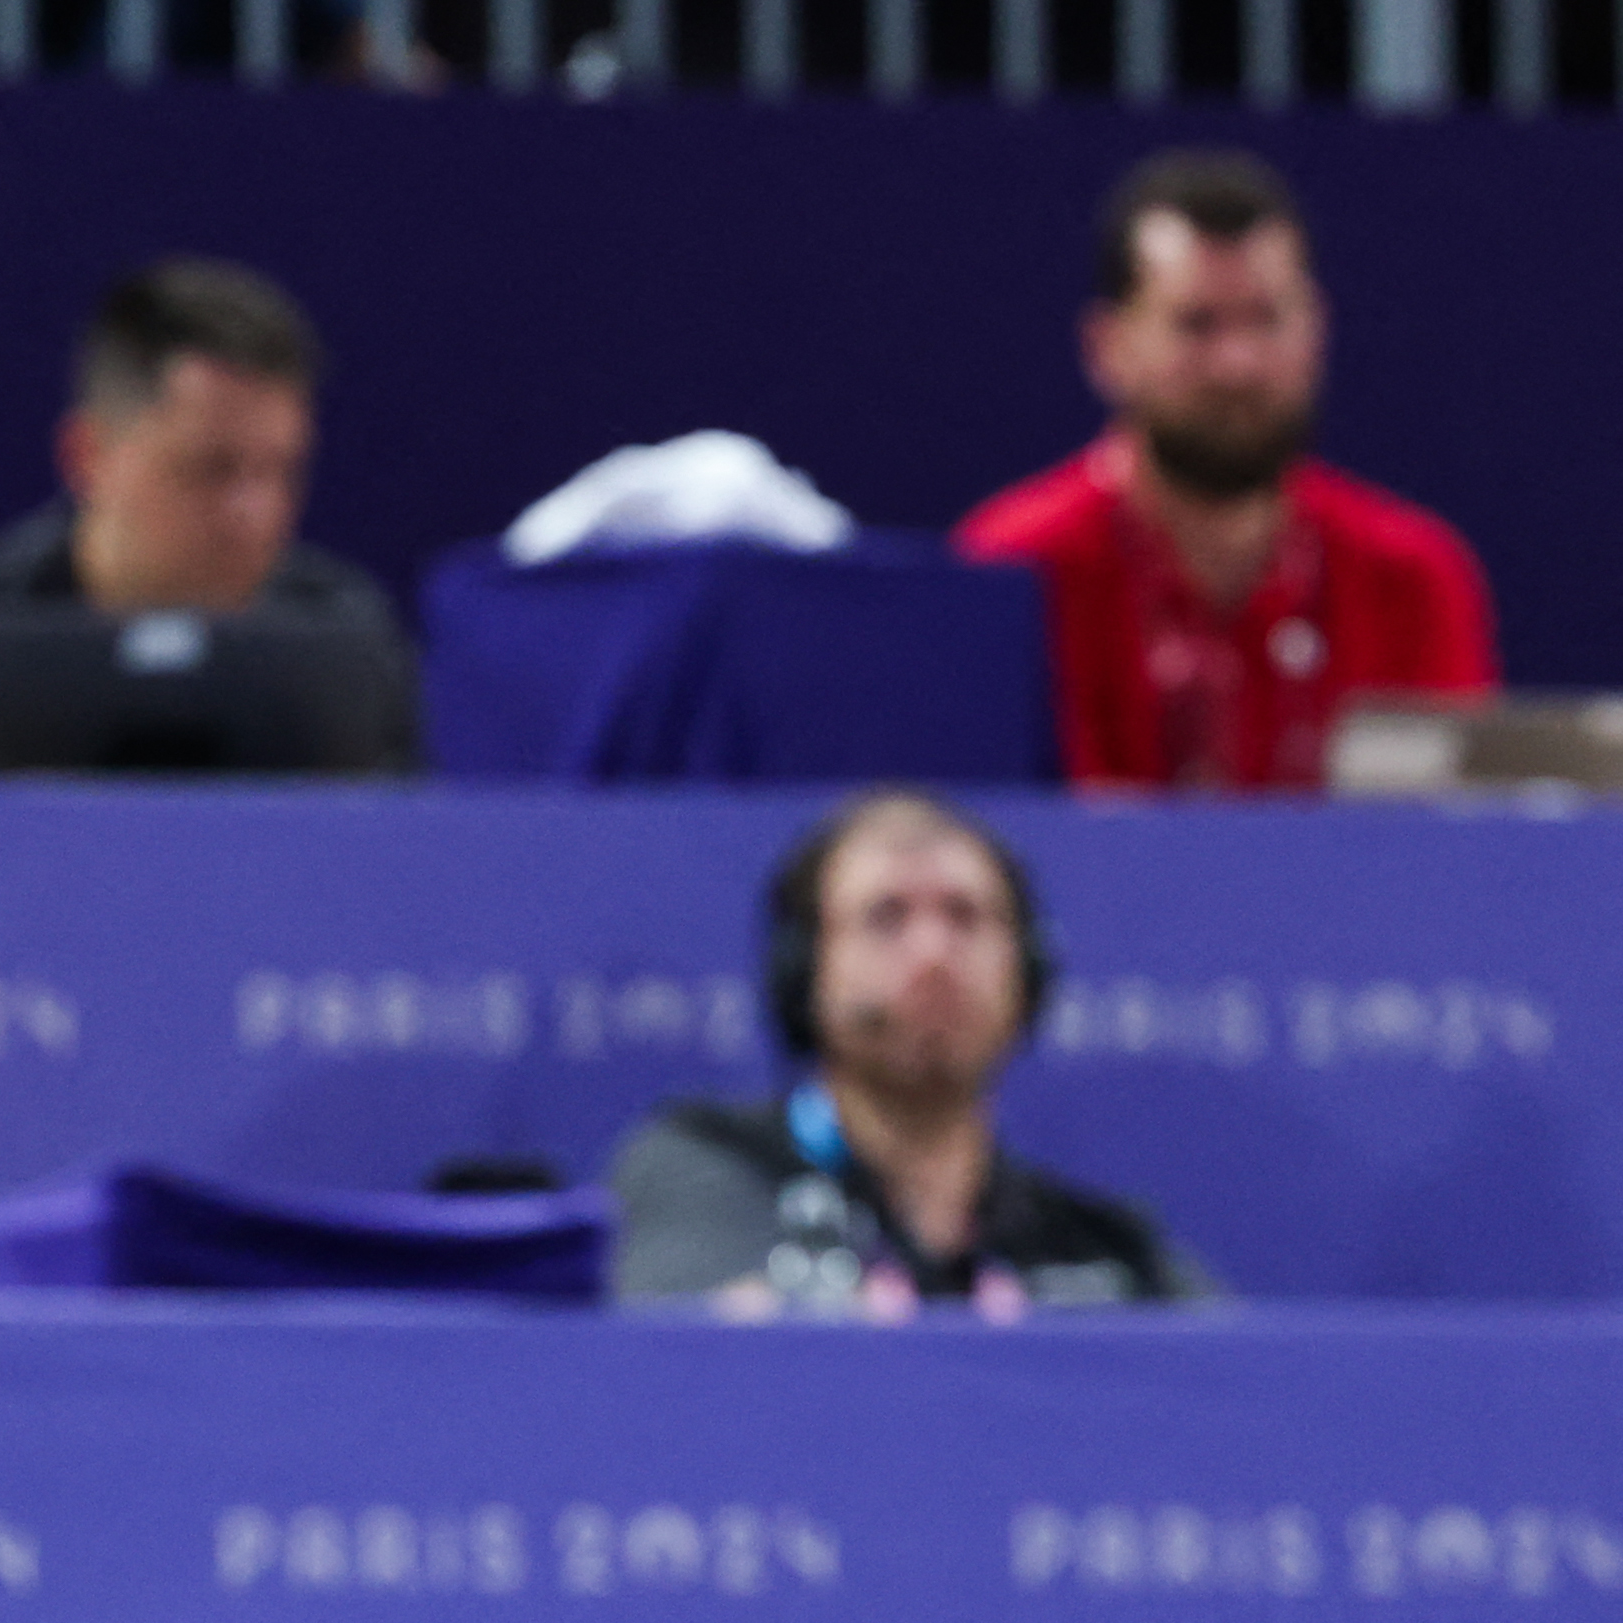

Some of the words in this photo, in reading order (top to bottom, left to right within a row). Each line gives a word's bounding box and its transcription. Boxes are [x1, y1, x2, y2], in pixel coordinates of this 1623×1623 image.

[553, 971, 753, 1064] 202
[1041, 974, 1268, 1068] ARIS
[214, 1502, 526, 1596] PARIS
[555, 1502, 841, 1598] 2024
[1010, 1501, 1323, 1596] PARIS
